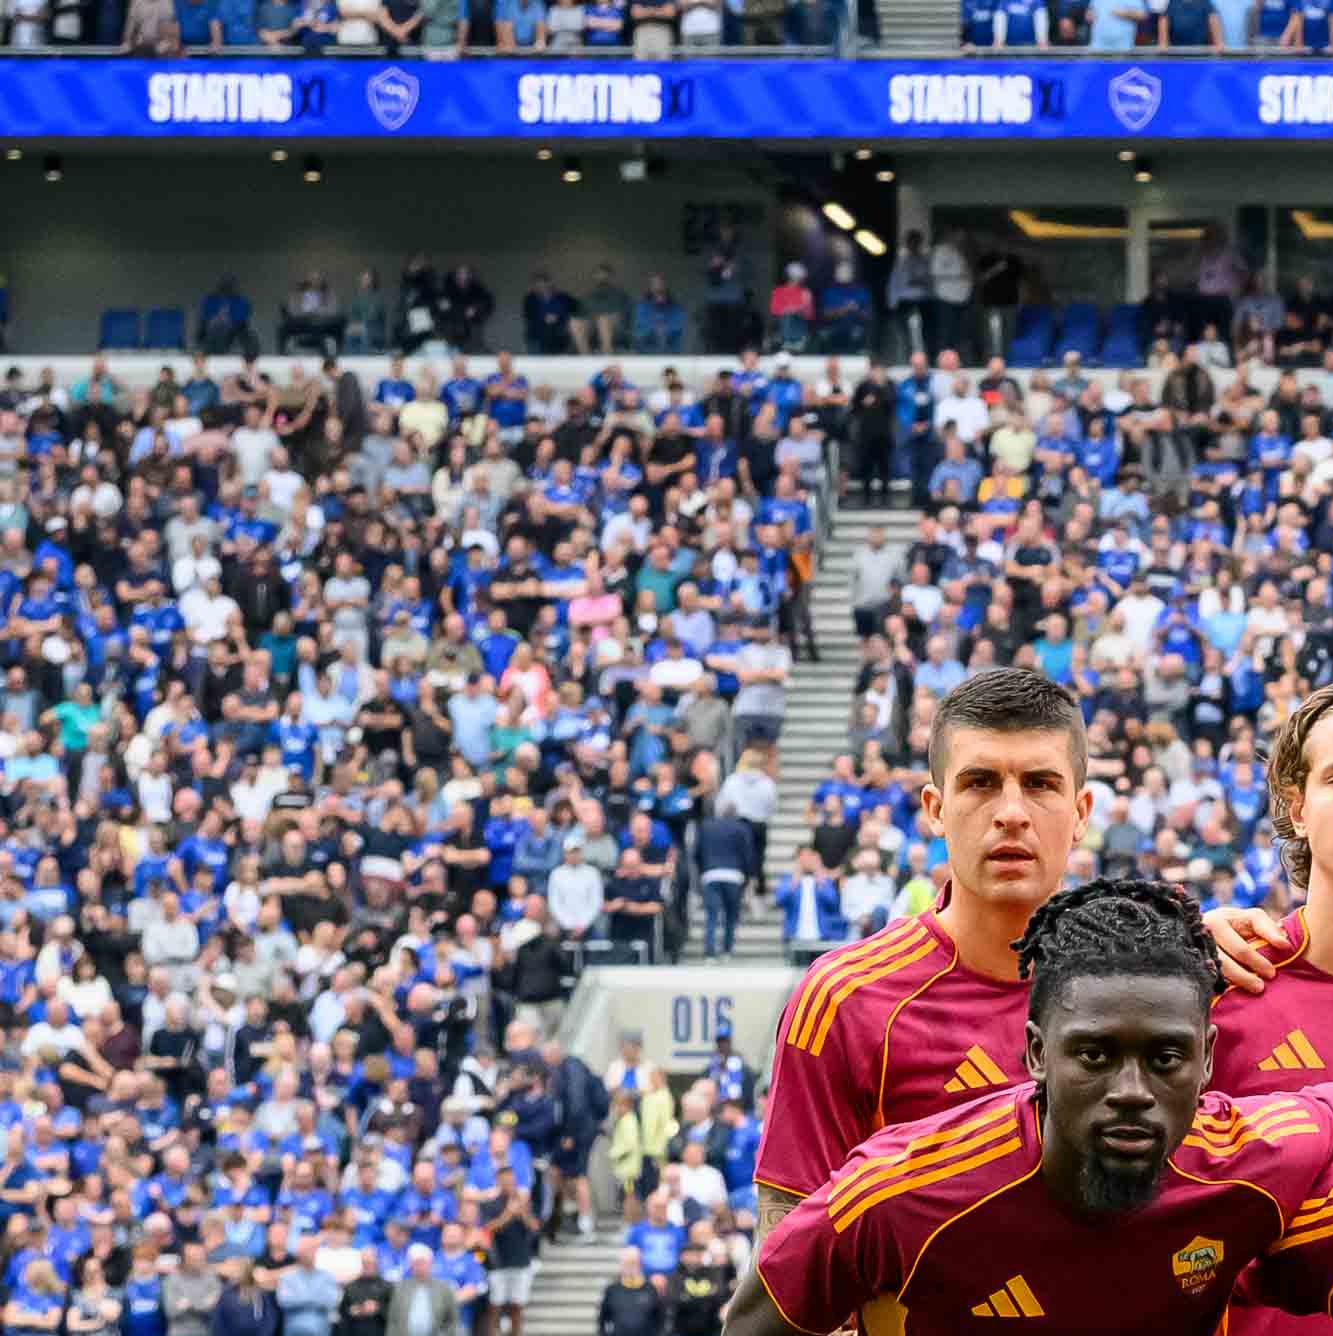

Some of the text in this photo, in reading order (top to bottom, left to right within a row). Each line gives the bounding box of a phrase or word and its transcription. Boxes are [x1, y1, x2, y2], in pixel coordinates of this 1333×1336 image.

[148, 73, 292, 122] STARTING
[518, 74, 662, 123] STARTING
[888, 74, 1032, 123] STARTING
